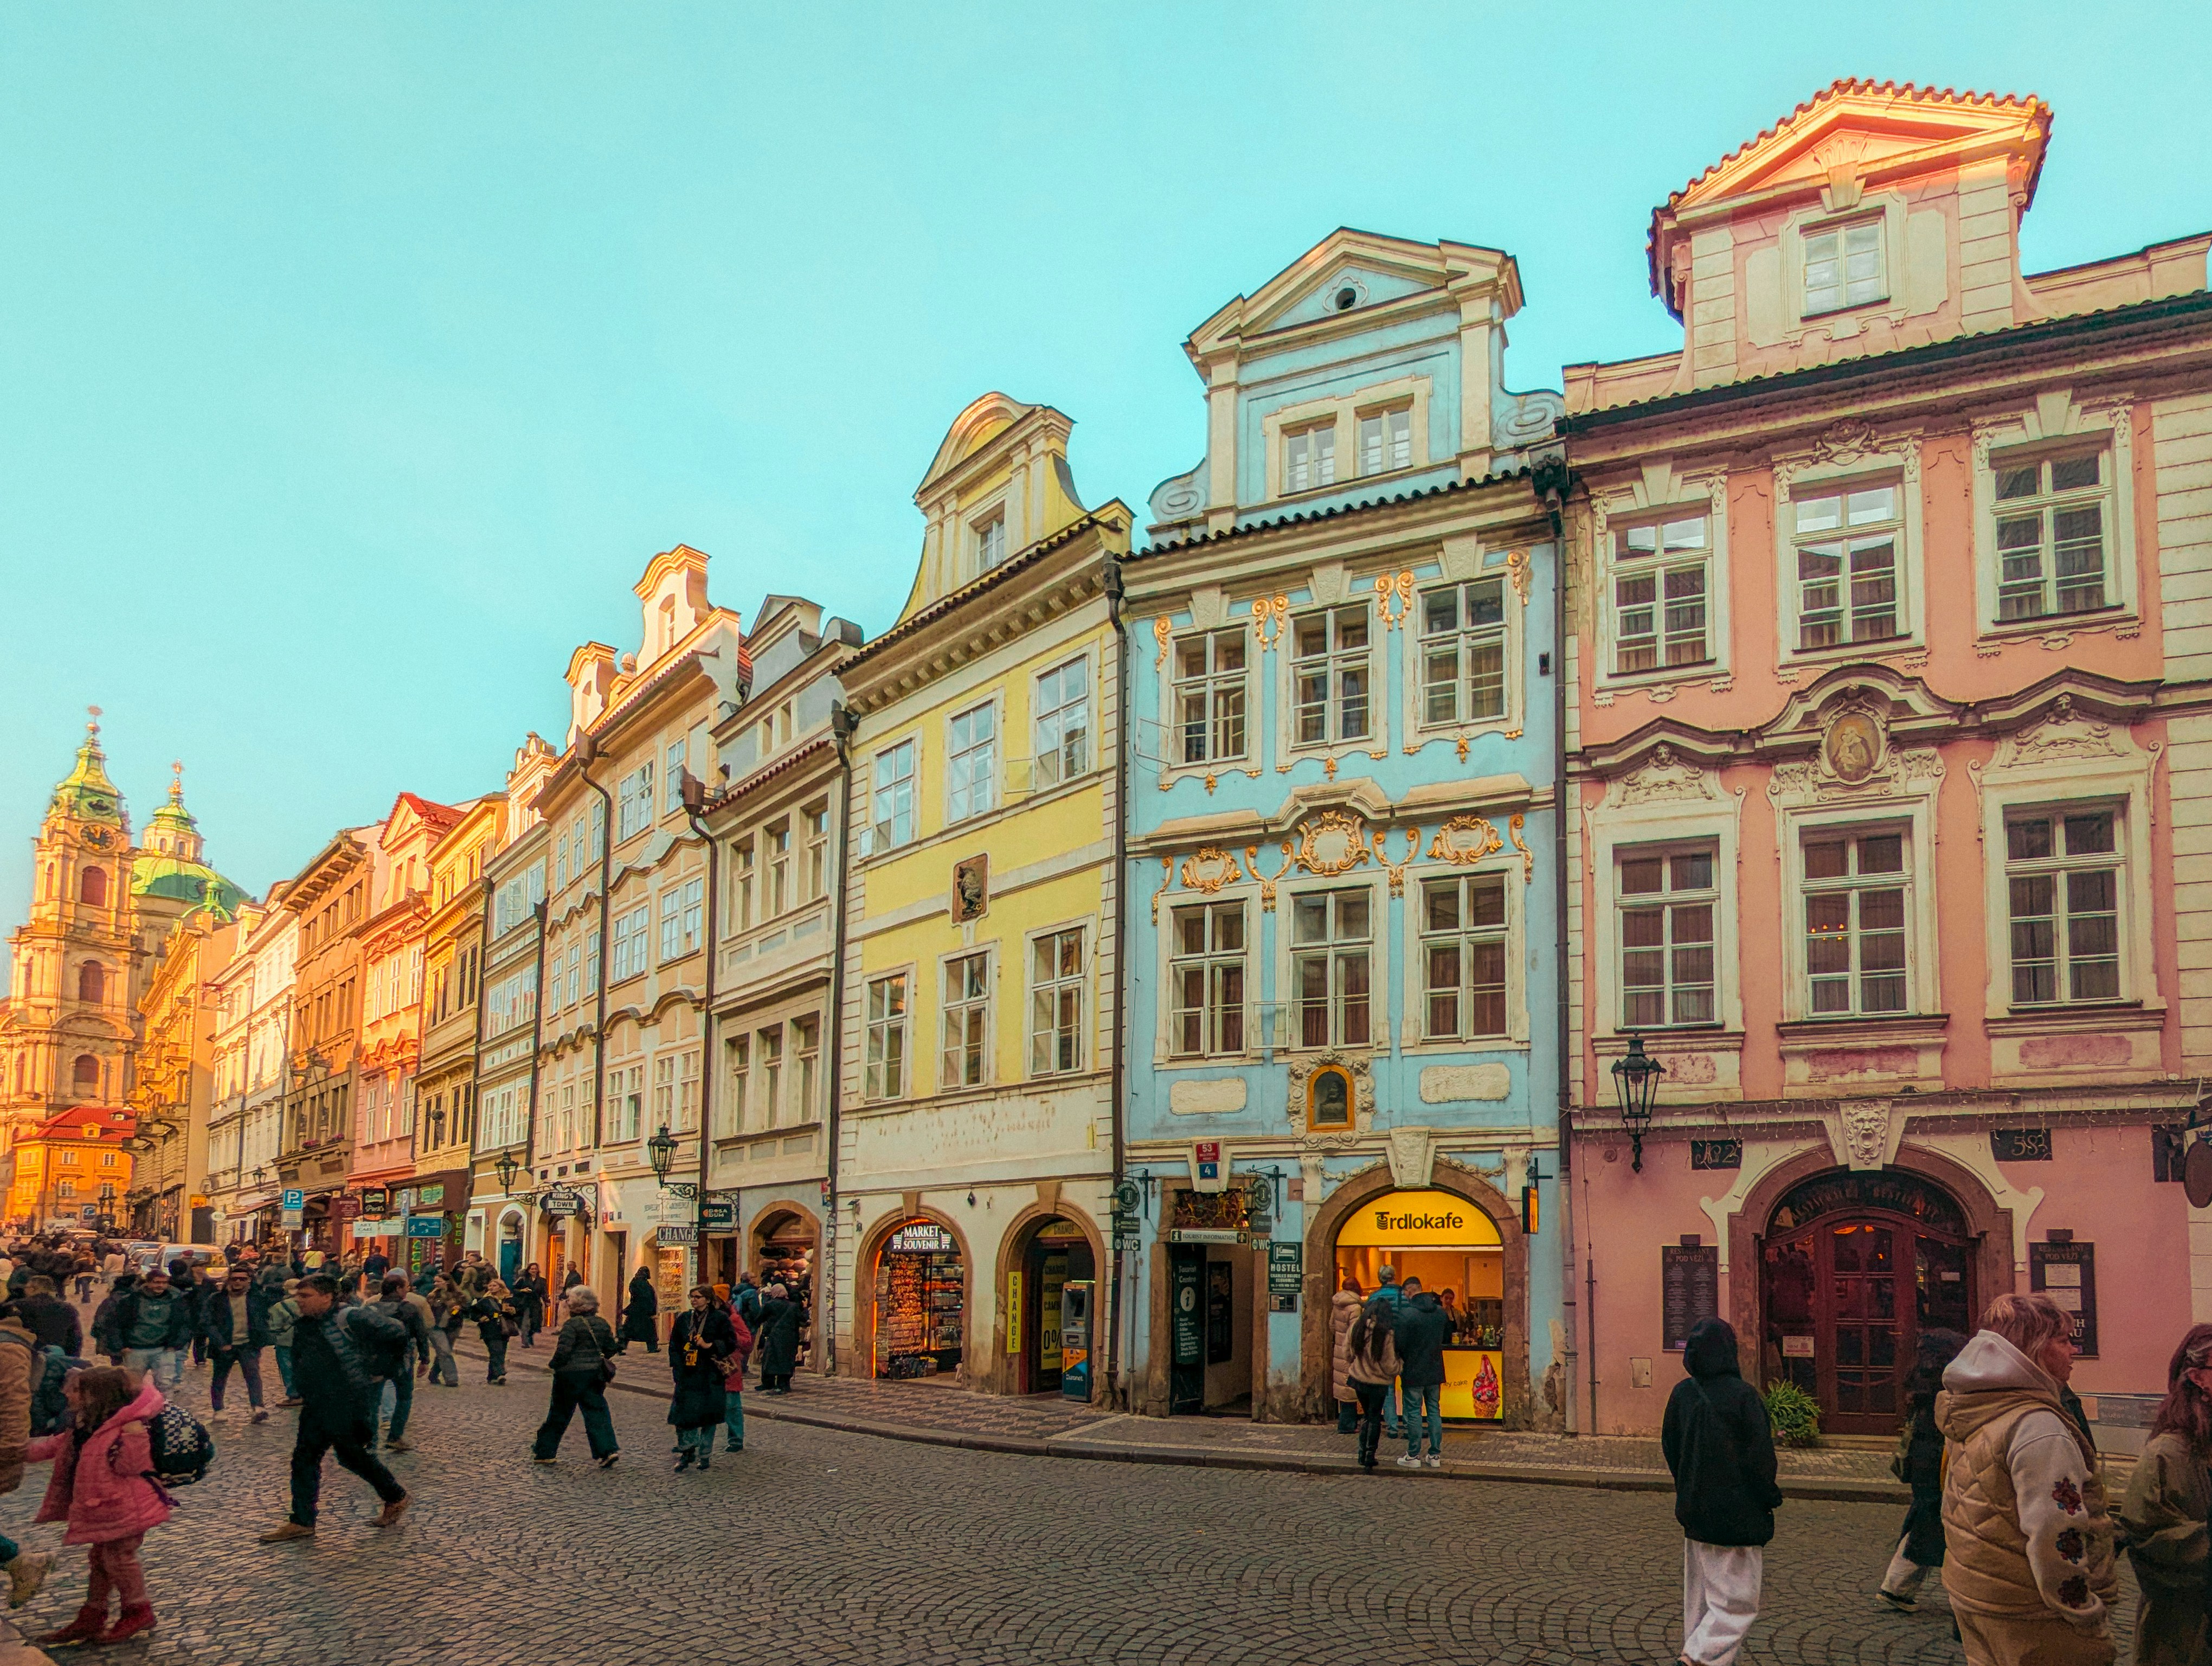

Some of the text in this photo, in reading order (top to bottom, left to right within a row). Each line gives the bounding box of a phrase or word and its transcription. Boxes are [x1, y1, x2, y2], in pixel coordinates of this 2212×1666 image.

[1202, 1144, 1212, 1152] 53
[1204, 1166, 1211, 1175] 4
[287, 1191, 299, 1203] P
[1375, 1212, 1463, 1230] Trdlokafe
[454, 1214, 465, 1245] WEED
[658, 1227, 698, 1241] CHANGE
[904, 1226, 940, 1238] MARKET
[1054, 1223, 1075, 1235] CHANGE
[903, 1240, 940, 1250] SOUVENIR
[1122, 1239, 1139, 1250] WC
[1258, 1239, 1271, 1250] WC
[1270, 1264, 1301, 1272] HOSTEL
